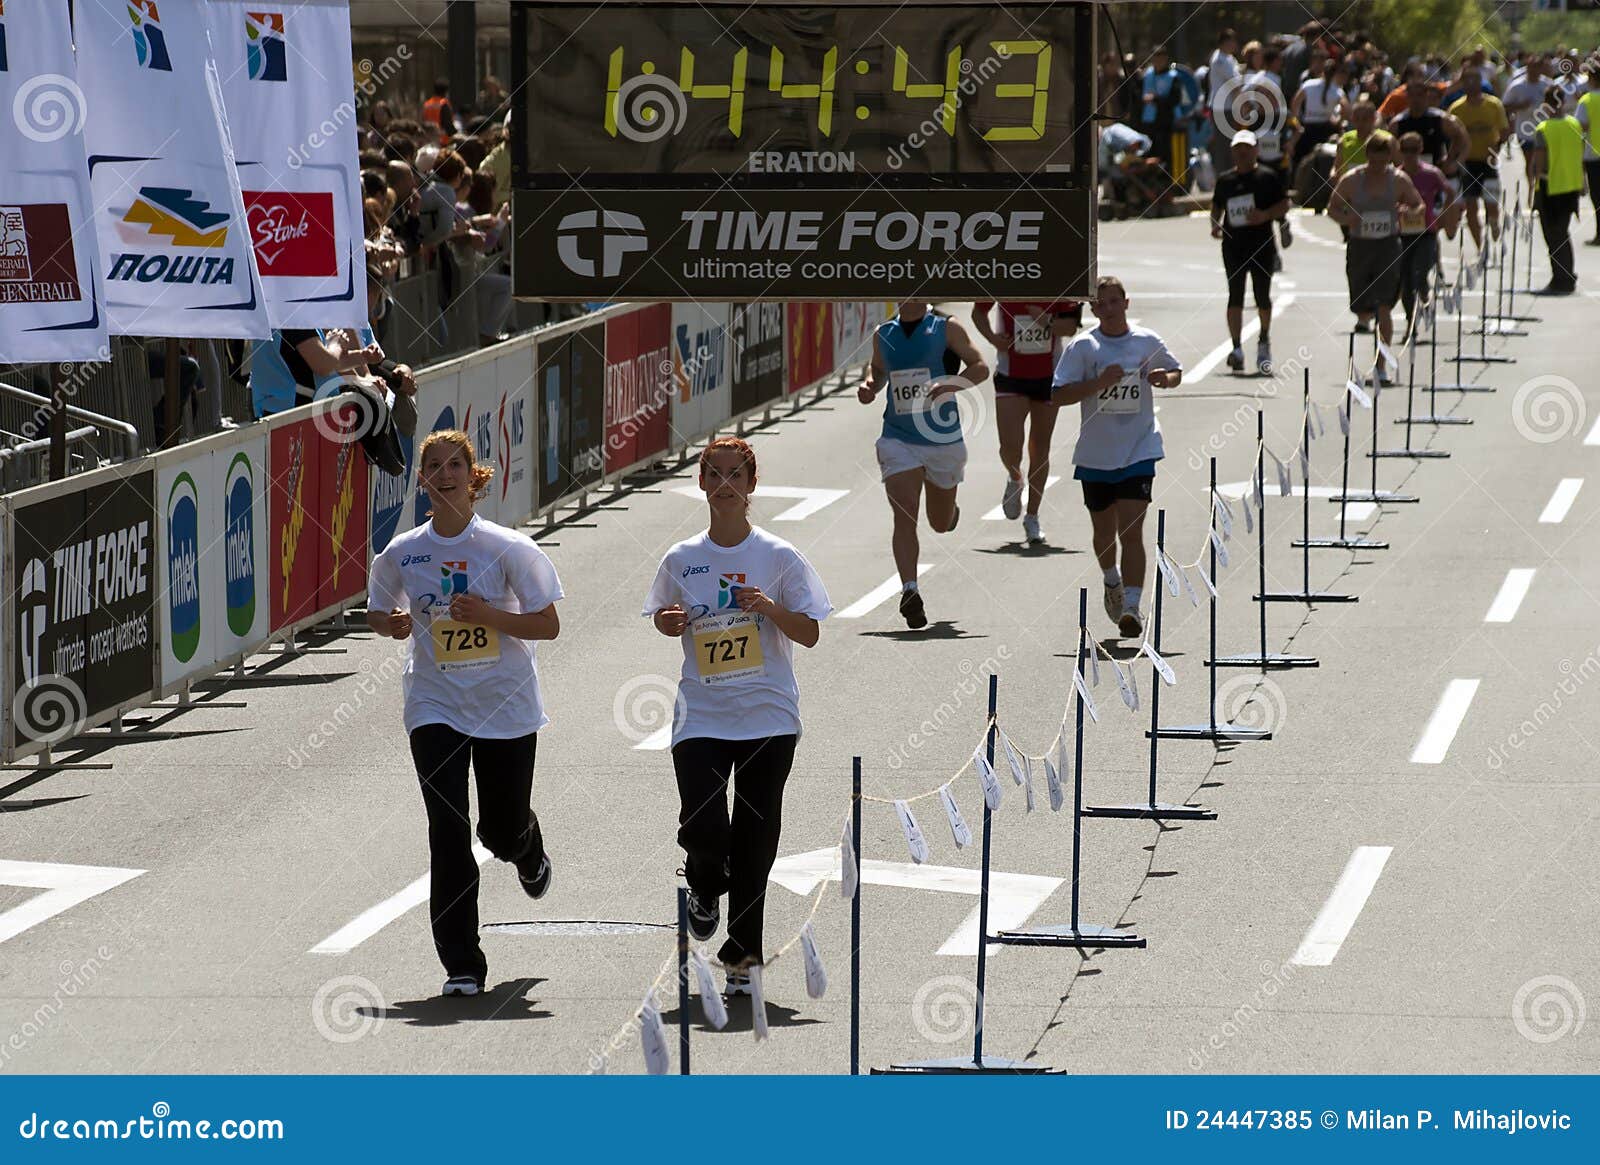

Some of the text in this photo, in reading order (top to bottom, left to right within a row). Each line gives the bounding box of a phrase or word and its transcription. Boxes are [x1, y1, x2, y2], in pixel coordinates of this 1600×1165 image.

[749, 151, 856, 173] ERATON
[681, 210, 1044, 250] TIME FORCE
[106, 253, 235, 285] ПОШТА
[683, 257, 1042, 284] ultimate concept watches
[1099, 384, 1140, 400] 2476
[227, 514, 253, 583] imlek
[53, 520, 148, 624] TIME FORCE
[171, 538, 198, 608] imlek
[115, 610, 147, 652] watches
[441, 626, 488, 652] 728
[704, 635, 749, 665] 727
